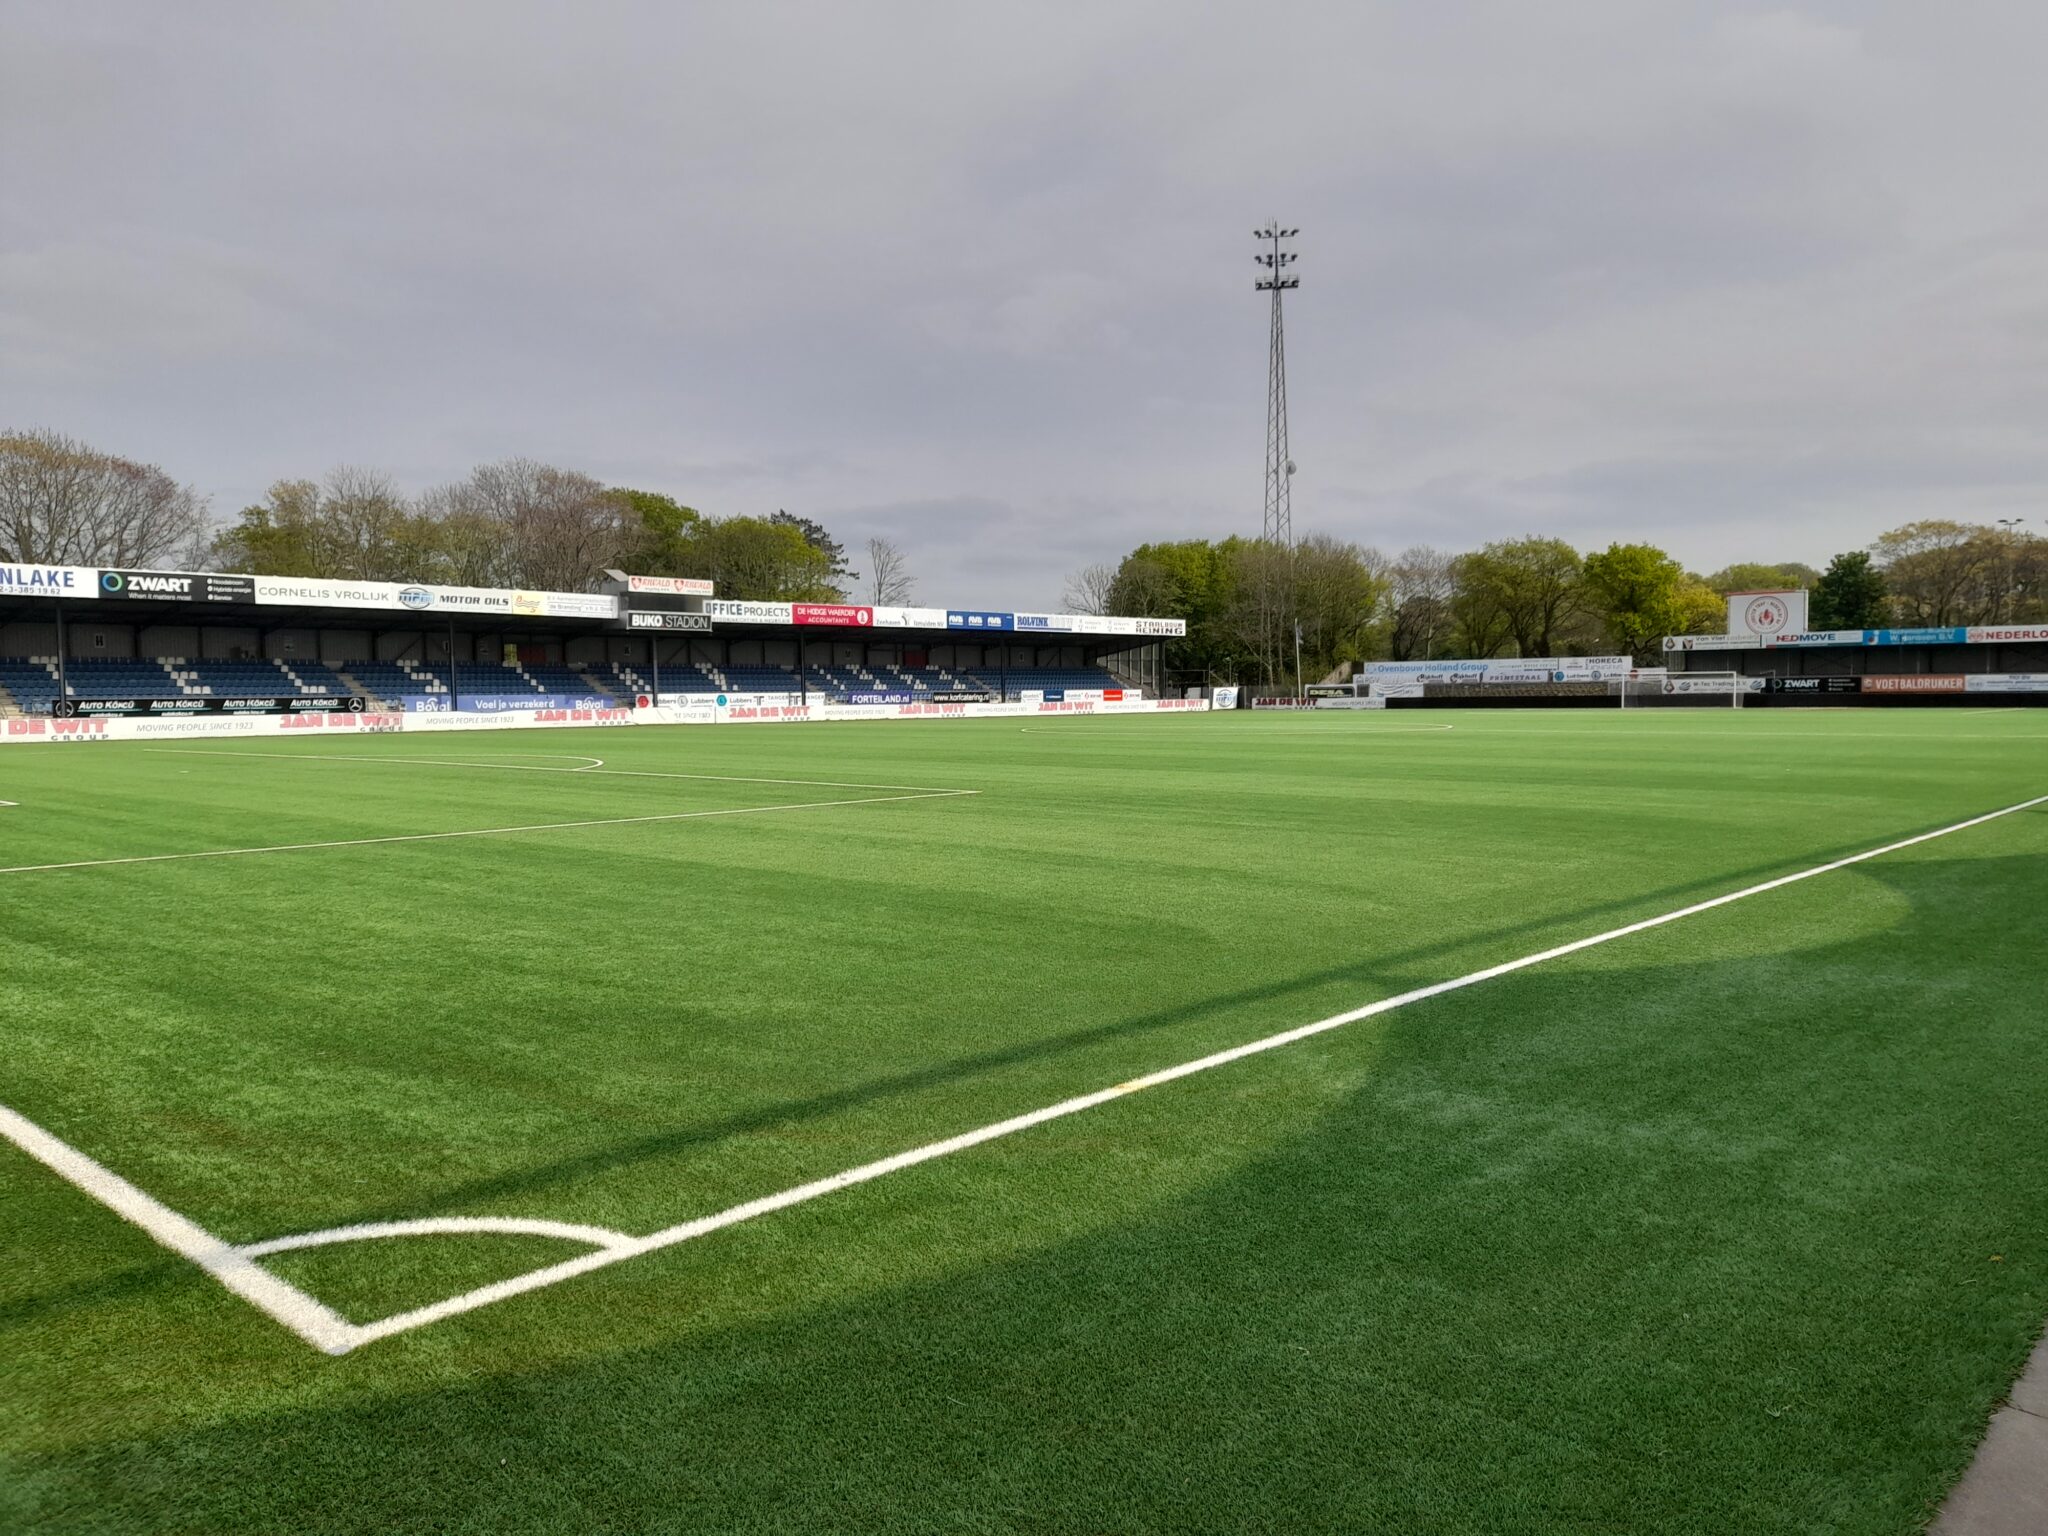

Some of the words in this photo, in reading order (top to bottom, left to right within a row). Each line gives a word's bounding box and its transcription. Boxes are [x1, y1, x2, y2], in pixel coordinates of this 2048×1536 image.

[127, 575, 192, 593] ZWART
[258, 586, 330, 599] CORNELIS
[334, 590, 389, 601] VROLIJK
[440, 595, 480, 605] MOTOR
[484, 597, 509, 606] OILS
[743, 607, 790, 617] PROJECTS
[797, 607, 806, 615] DE
[828, 609, 856, 617] WAERDER
[665, 615, 708, 629] STADION
[1017, 616, 1048, 627] ROLVINK
[1776, 634, 1836, 642] NEDMOVE
[1986, 630, 2048, 640] NEDERLO
[1378, 664, 1423, 673] Ovenbouw
[1460, 663, 1488, 673] Group
[1784, 679, 1820, 688] ZWART
[1875, 678, 1963, 690] VOETBALDRUKKER
[79, 701, 104, 709] AUTO
[150, 700, 174, 708] AUTO
[290, 699, 311, 707] AUTO
[416, 701, 450, 712] Boval
[475, 699, 496, 709] Voel
[498, 700, 507, 711] je
[508, 699, 555, 709] verzekerd
[575, 700, 604, 710] Boval
[1038, 702, 1058, 711] JAN
[1074, 701, 1094, 710] WIT
[1187, 699, 1203, 707] WIT
[1255, 698, 1276, 706] JAN
[1295, 698, 1318, 706] WIT
[729, 707, 757, 718] JAN
[760, 706, 779, 717] DE
[781, 706, 810, 716] WIT
[898, 704, 922, 714] JAN
[924, 704, 940, 713] DE
[941, 703, 966, 713] WIT
[534, 710, 567, 722] JAN
[571, 709, 592, 721] DE
[595, 708, 627, 721] WIT
[280, 713, 323, 728] JAN
[328, 713, 356, 726] DE
[360, 713, 403, 726] WIT
[456, 717, 478, 725] PEOPLE
[481, 716, 498, 724] SINCE
[8, 720, 46, 735] DE
[51, 718, 108, 734] WIT
[137, 724, 174, 732] MOVING
[176, 722, 207, 731] PEOPLE
[209, 722, 233, 730] SINCE
[235, 721, 254, 730] 1923
